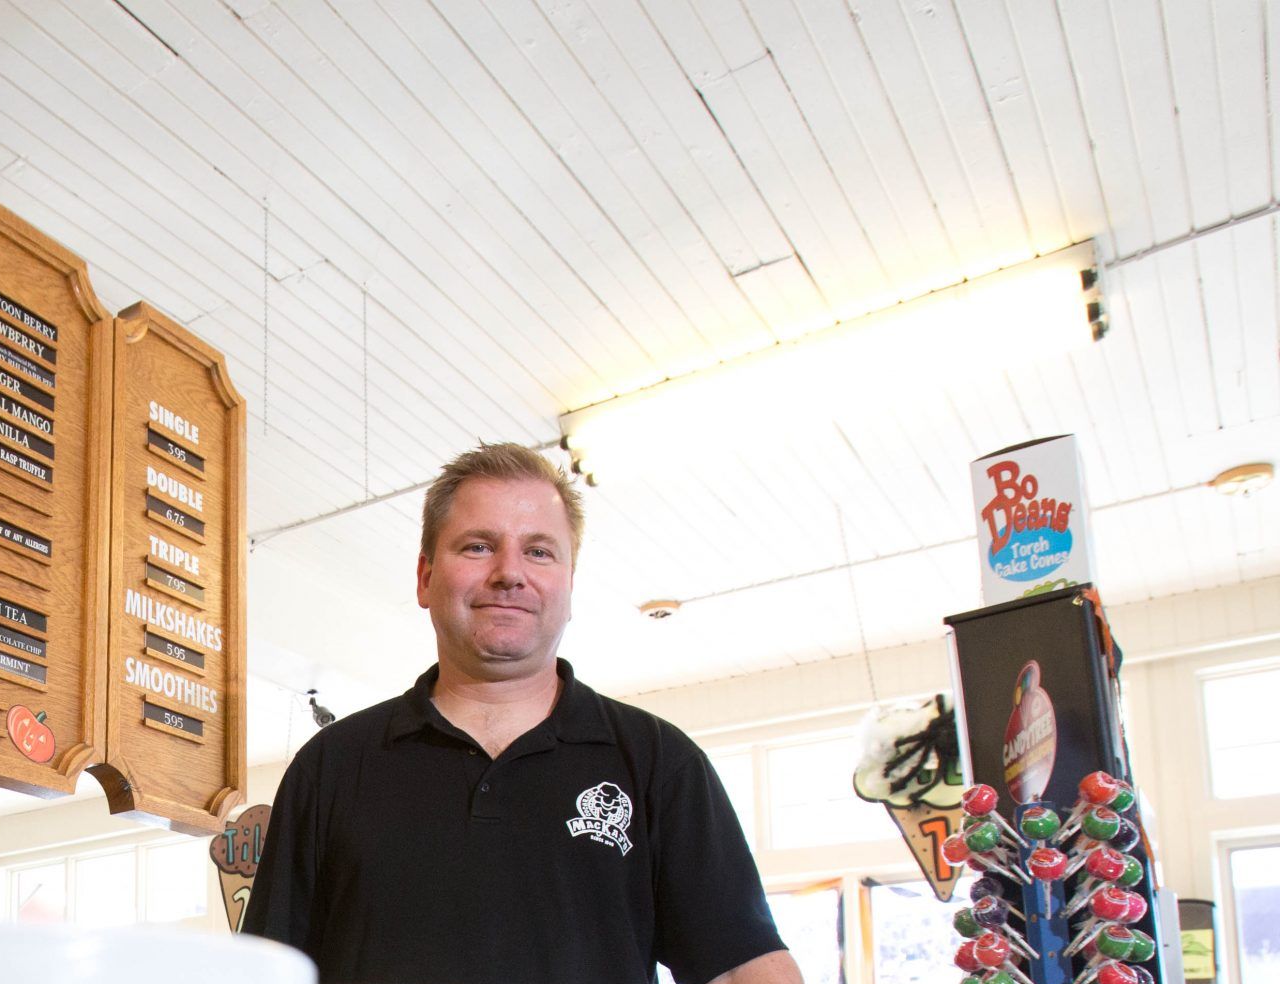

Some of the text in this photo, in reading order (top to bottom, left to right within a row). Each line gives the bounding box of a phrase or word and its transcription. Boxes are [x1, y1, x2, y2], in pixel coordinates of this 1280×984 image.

[23, 312, 56, 341] BERRY
[12, 402, 51, 434] MANGO
[149, 400, 199, 445] SINGLE
[0, 449, 18, 467] RASP
[19, 458, 46, 481] TRUFFLE
[168, 443, 186, 462] 3.95
[147, 464, 203, 513] DOUBLE
[986, 460, 1039, 506] Bo
[166, 509, 185, 527] 6.75
[149, 535, 200, 576] TRIPLE
[995, 551, 1068, 577] Cake Cones
[166, 575, 186, 593] 7.95
[5, 605, 28, 625] TEA
[125, 589, 223, 652] MILKSHAKES
[26, 645, 42, 655] CHIP
[166, 644, 186, 661] 5.95
[125, 657, 218, 714] SMOOTHIES
[164, 712, 184, 729] 5.95
